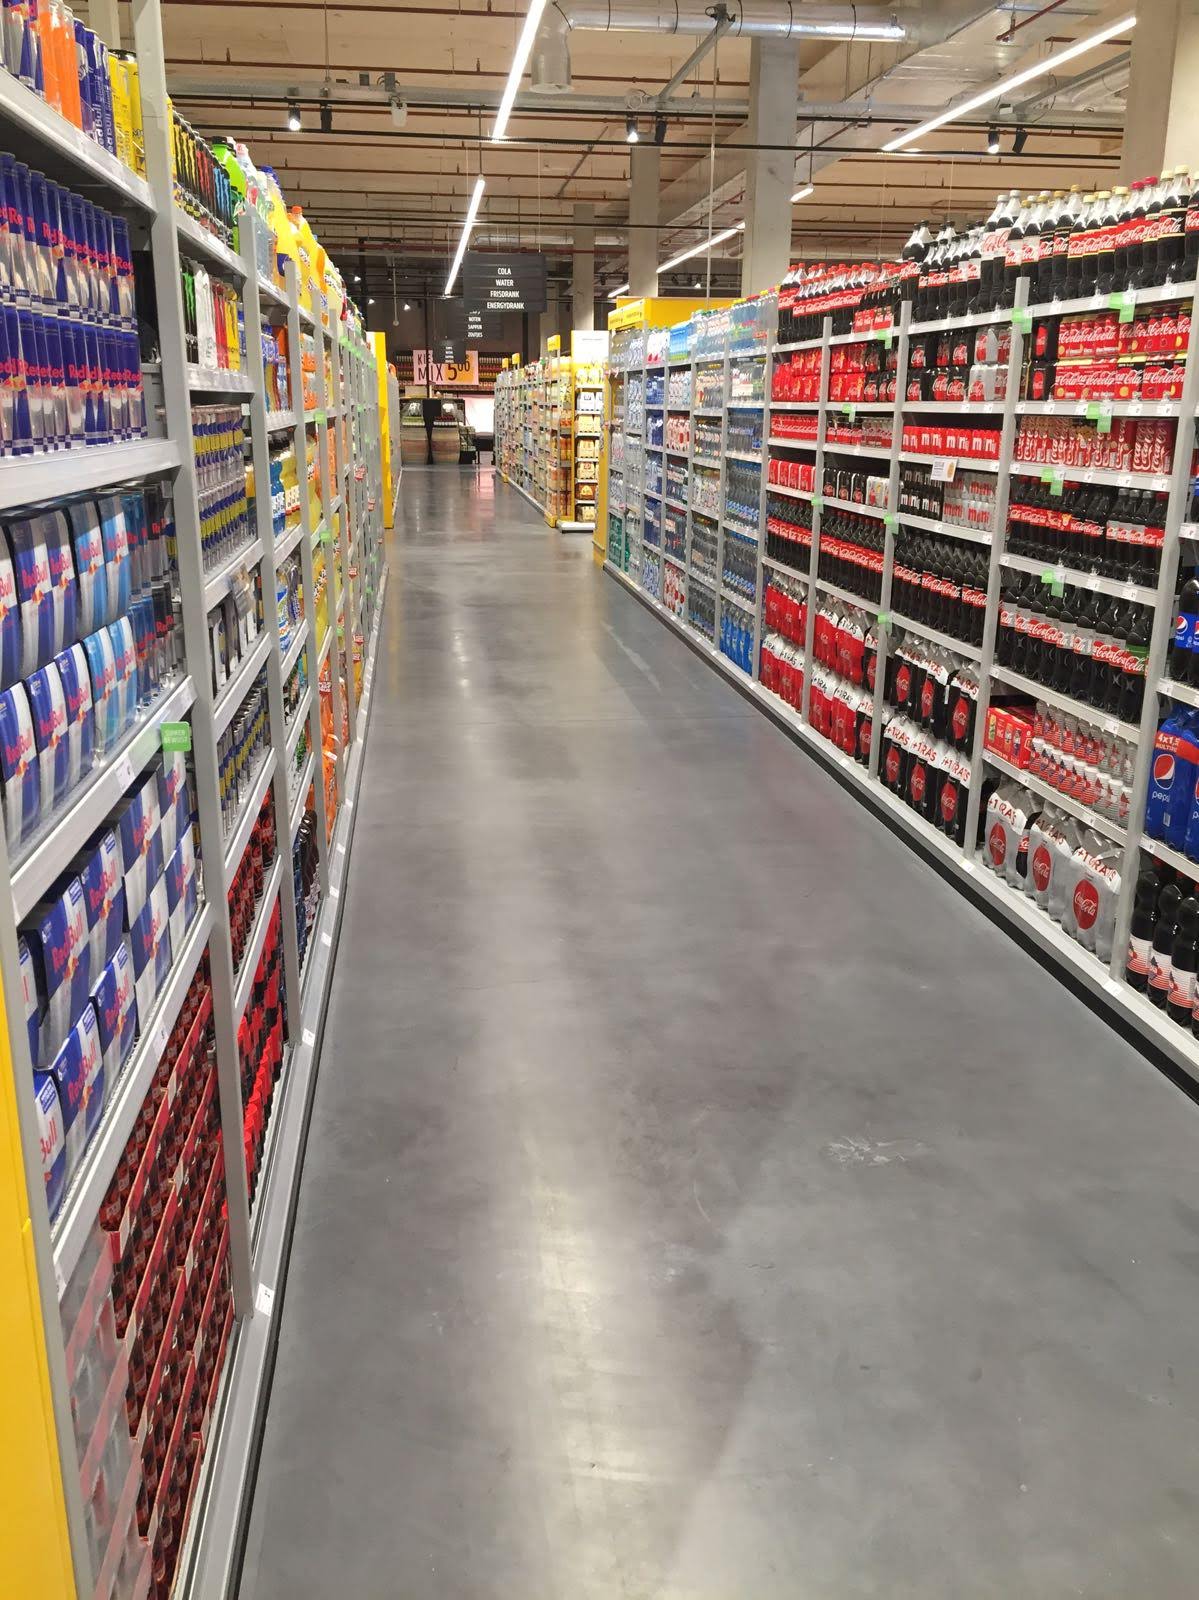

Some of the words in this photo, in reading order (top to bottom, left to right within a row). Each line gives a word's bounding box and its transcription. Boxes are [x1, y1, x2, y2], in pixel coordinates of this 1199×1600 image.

[497, 267, 512, 275] COLA
[490, 290, 520, 298] FRISDRANK
[486, 301, 525, 310] ENERGYDRANK
